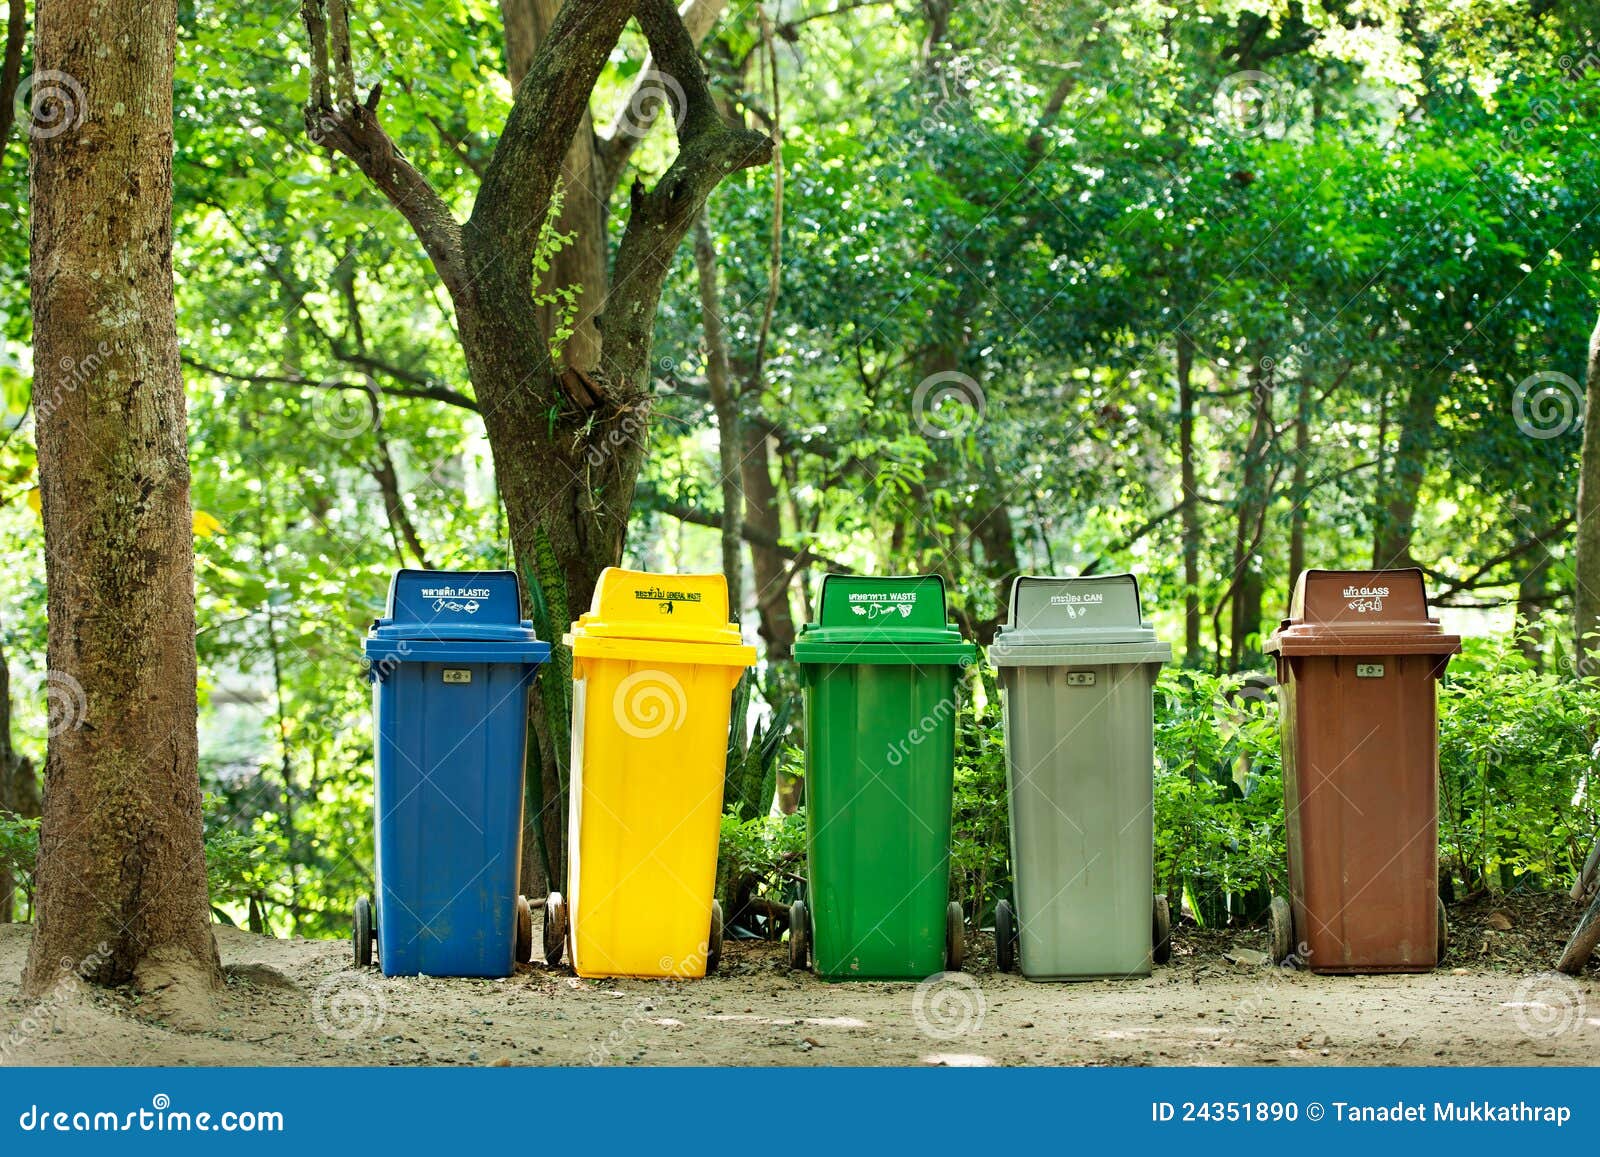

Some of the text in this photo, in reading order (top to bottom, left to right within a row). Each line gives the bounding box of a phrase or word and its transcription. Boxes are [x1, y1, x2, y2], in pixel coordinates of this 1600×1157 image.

[458, 588, 490, 597] PLASTIC
[666, 591, 686, 600] GENERAL
[686, 592, 701, 601] WASTE
[1360, 587, 1390, 596] GLASS
[890, 592, 917, 601] WASTE
[1084, 593, 1103, 602] CAN
